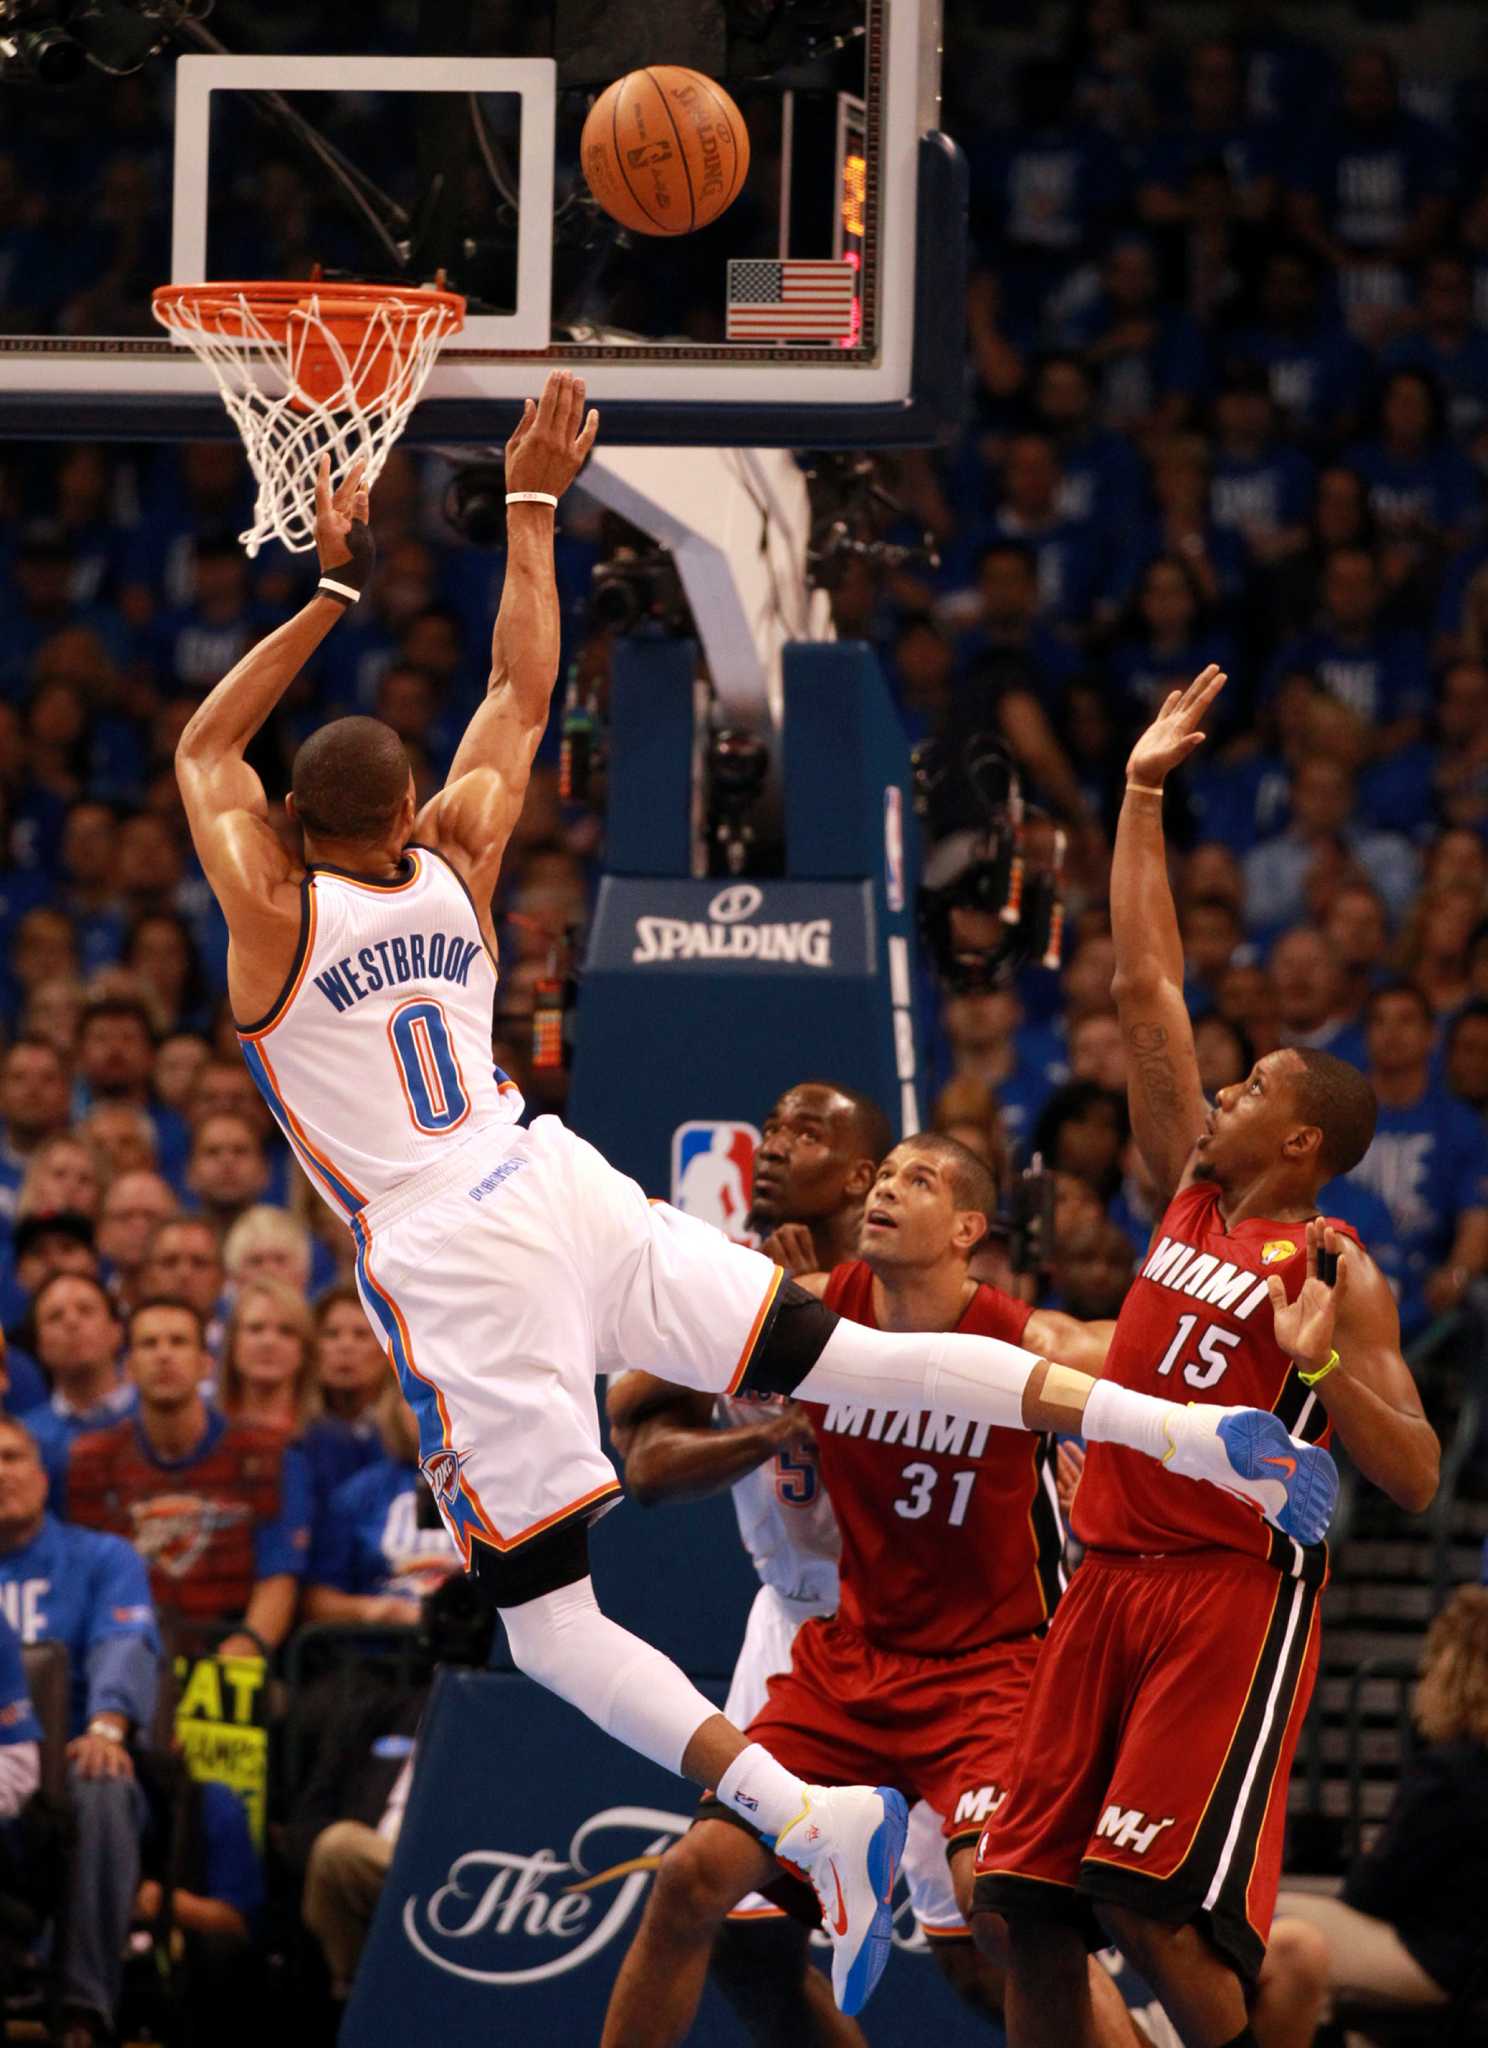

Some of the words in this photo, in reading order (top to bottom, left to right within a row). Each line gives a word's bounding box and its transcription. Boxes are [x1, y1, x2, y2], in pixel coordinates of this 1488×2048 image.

[670, 85, 724, 200] SPALDING
[313, 932, 483, 1013] WESTBROOK
[632, 915, 833, 968] SPALDING
[386, 994, 472, 1137] 0
[1142, 1236, 1270, 1320] MIAMI
[1157, 1314, 1241, 1389] 15
[822, 1402, 992, 1458] MIAMI
[894, 1461, 977, 1527] 31
[427, 1847, 593, 1938] The
